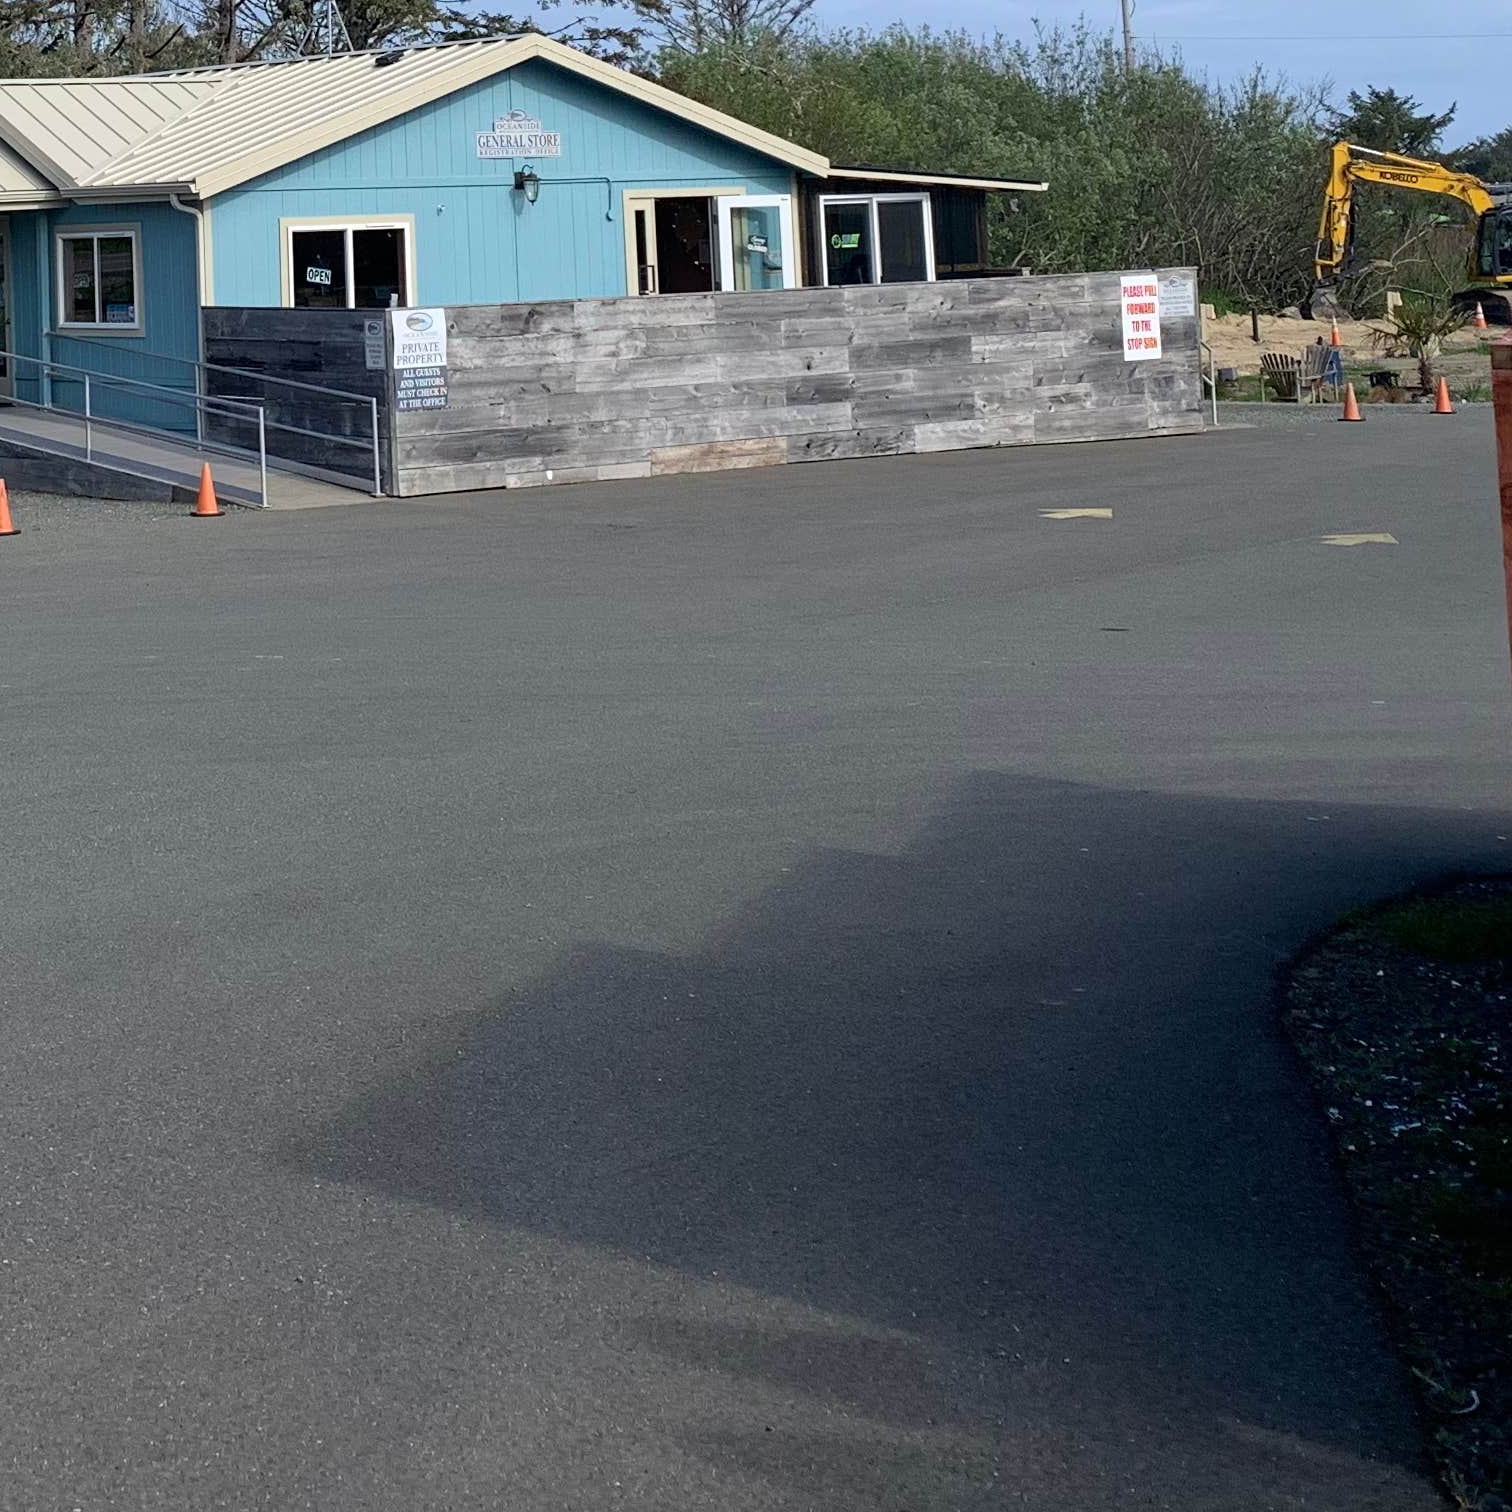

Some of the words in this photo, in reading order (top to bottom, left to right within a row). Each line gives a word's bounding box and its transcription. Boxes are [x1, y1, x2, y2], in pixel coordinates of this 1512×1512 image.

[478, 134, 526, 148] GENERAL
[528, 133, 559, 147] STORE
[308, 268, 331, 283] OPEN
[1123, 285, 1144, 297] PLEASE
[1126, 302, 1155, 315] FORWARD
[1132, 321, 1140, 333] TO
[1141, 320, 1152, 332] THE
[402, 341, 441, 354] PRIVATE
[1127, 338, 1142, 350] STOP
[1143, 336, 1157, 349] SIGN
[396, 353, 444, 366] PROPERTY
[402, 369, 416, 378] ALL
[416, 367, 441, 377] GUESTS
[400, 379, 414, 388] AND
[414, 377, 445, 387] VISITORS
[397, 389, 416, 398] MUST
[416, 387, 439, 397] CHECK
[439, 387, 448, 396] IN
[399, 399, 408, 408] AT
[408, 398, 422, 408] THE
[422, 397, 446, 407] OFFICE
